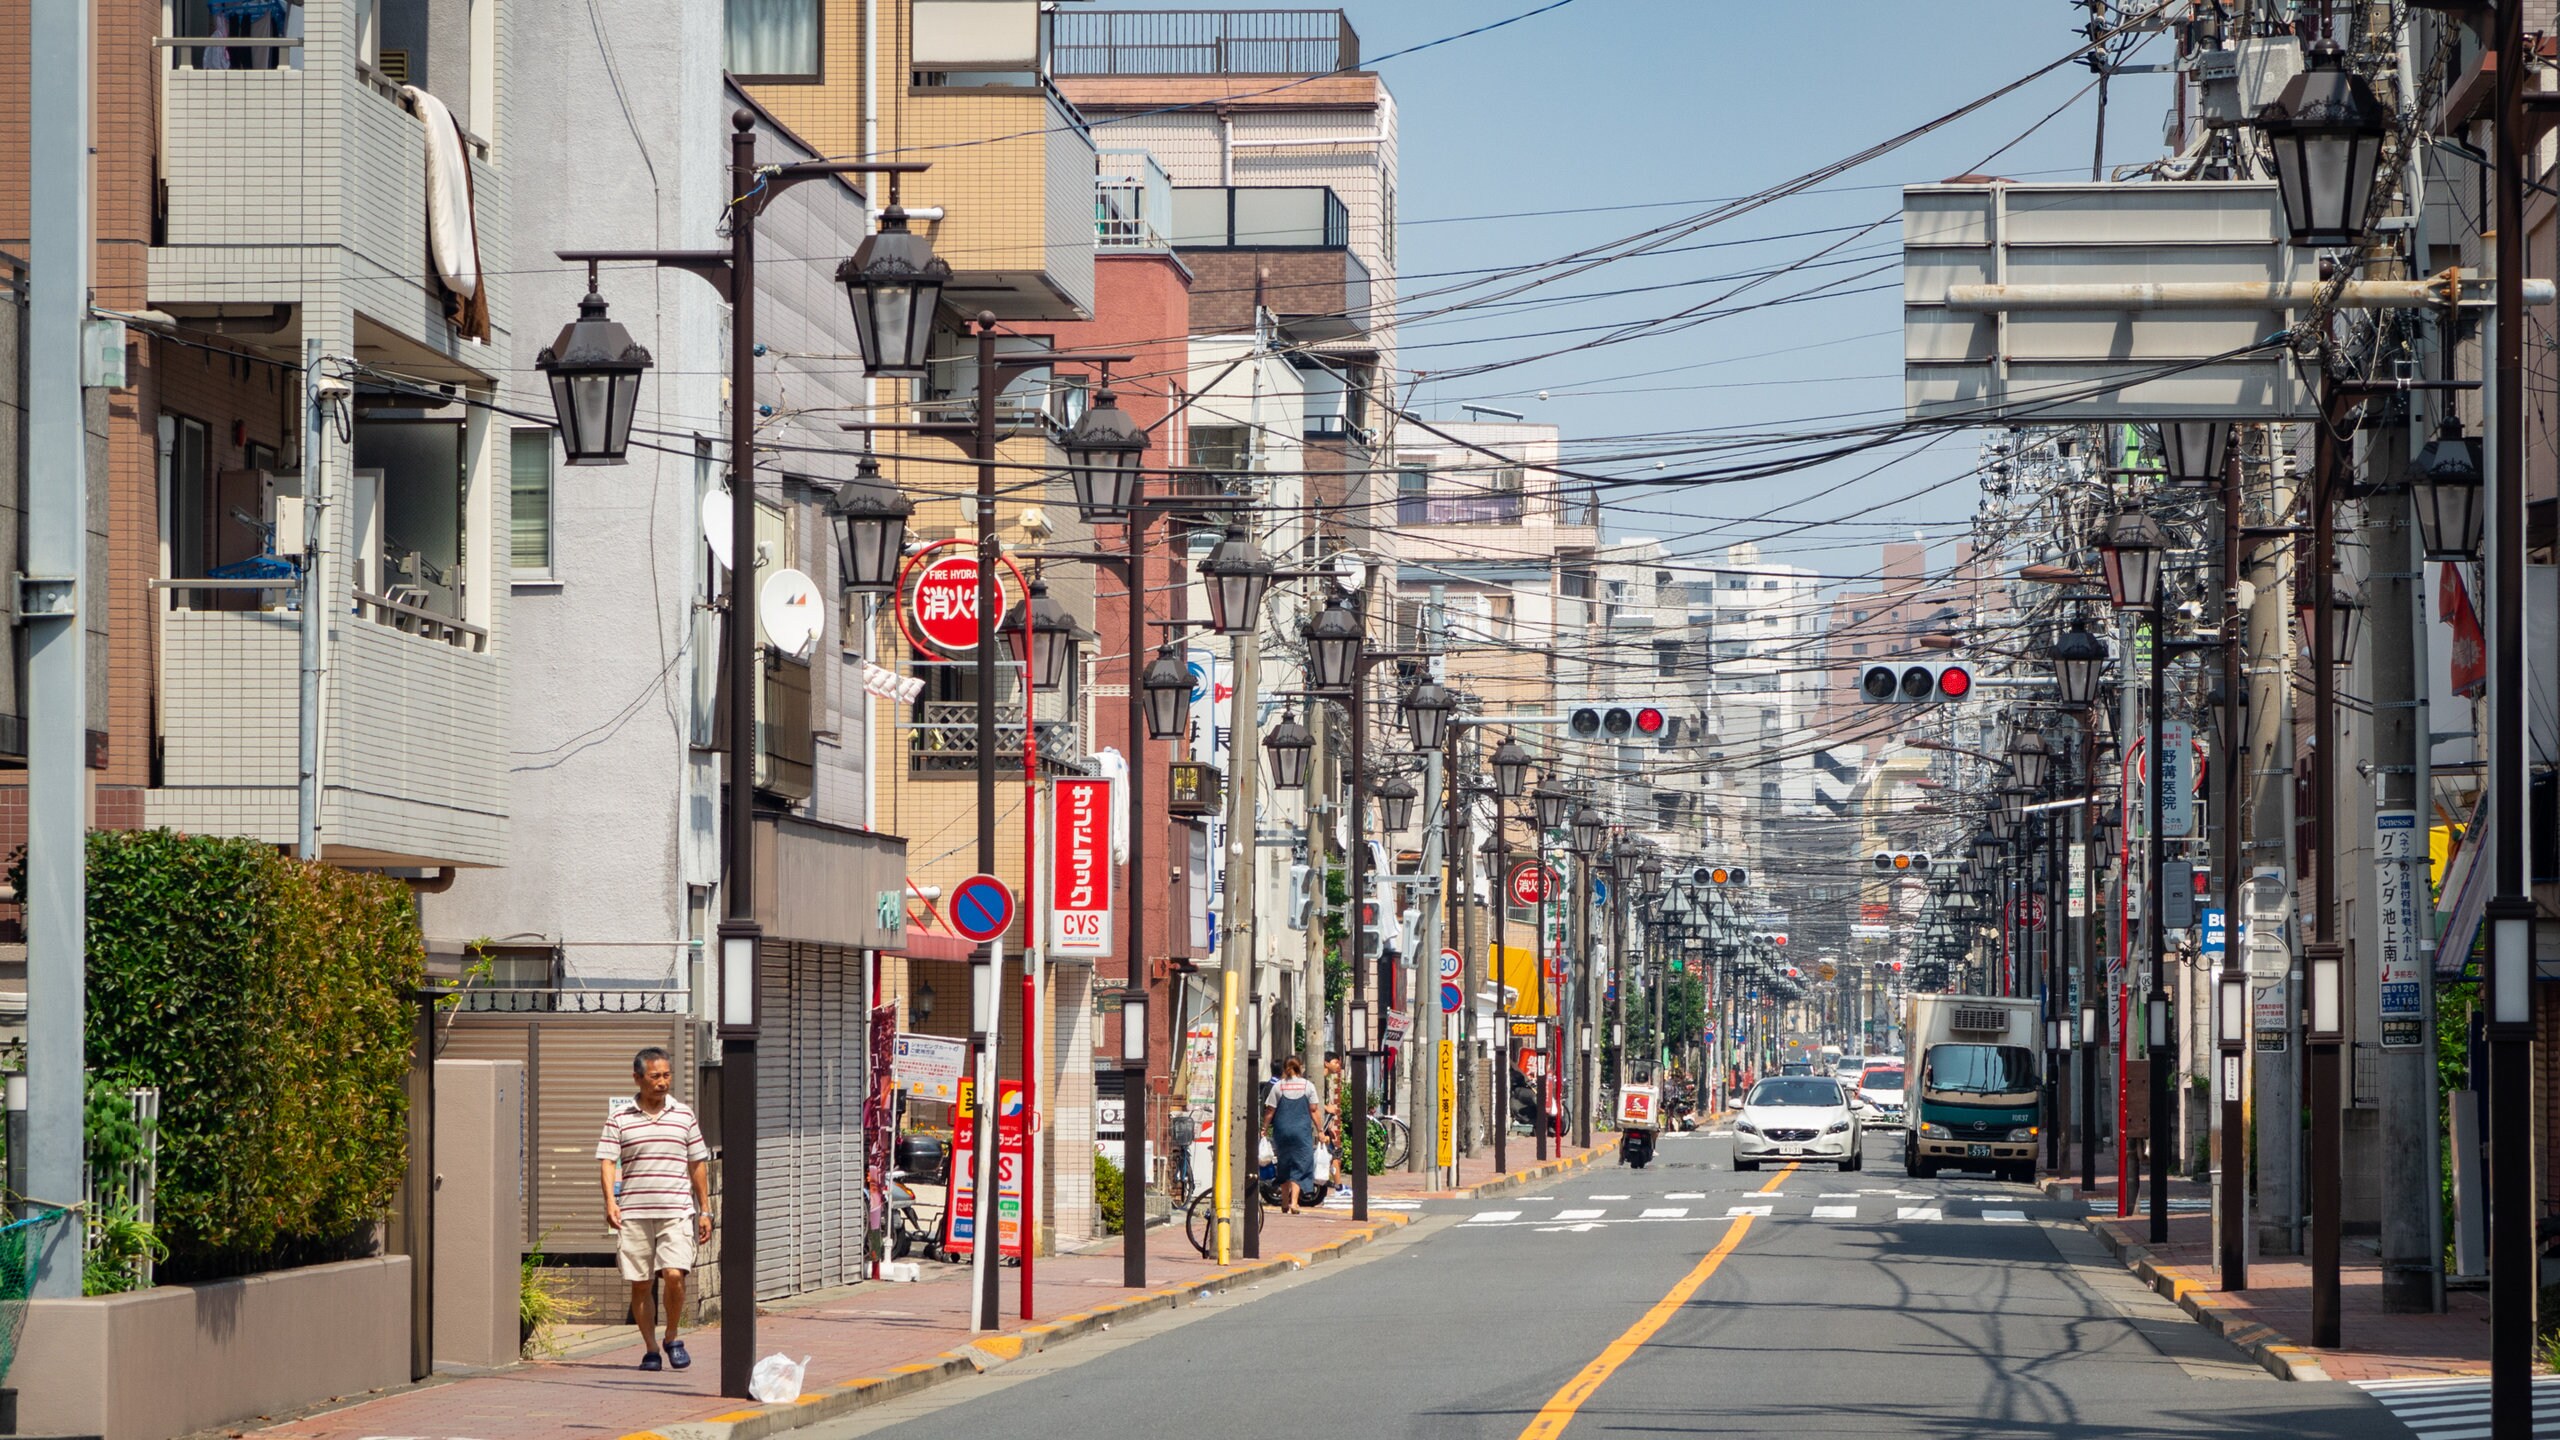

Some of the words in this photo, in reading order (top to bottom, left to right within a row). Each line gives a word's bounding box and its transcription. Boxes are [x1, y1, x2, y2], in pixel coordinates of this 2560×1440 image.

[929, 570, 948, 580] FIRE
[950, 569, 978, 580] HYDRA
[2161, 749, 2177, 810] 野溝医院
[2379, 818, 2412, 827] Benesse
[1070, 785, 1094, 908] サンドラッグ
[2381, 832, 2397, 905] グランダ
[1063, 914, 1099, 935] CVS
[2382, 908, 2397, 962] 池上南
[1440, 958, 1456, 971] 30
